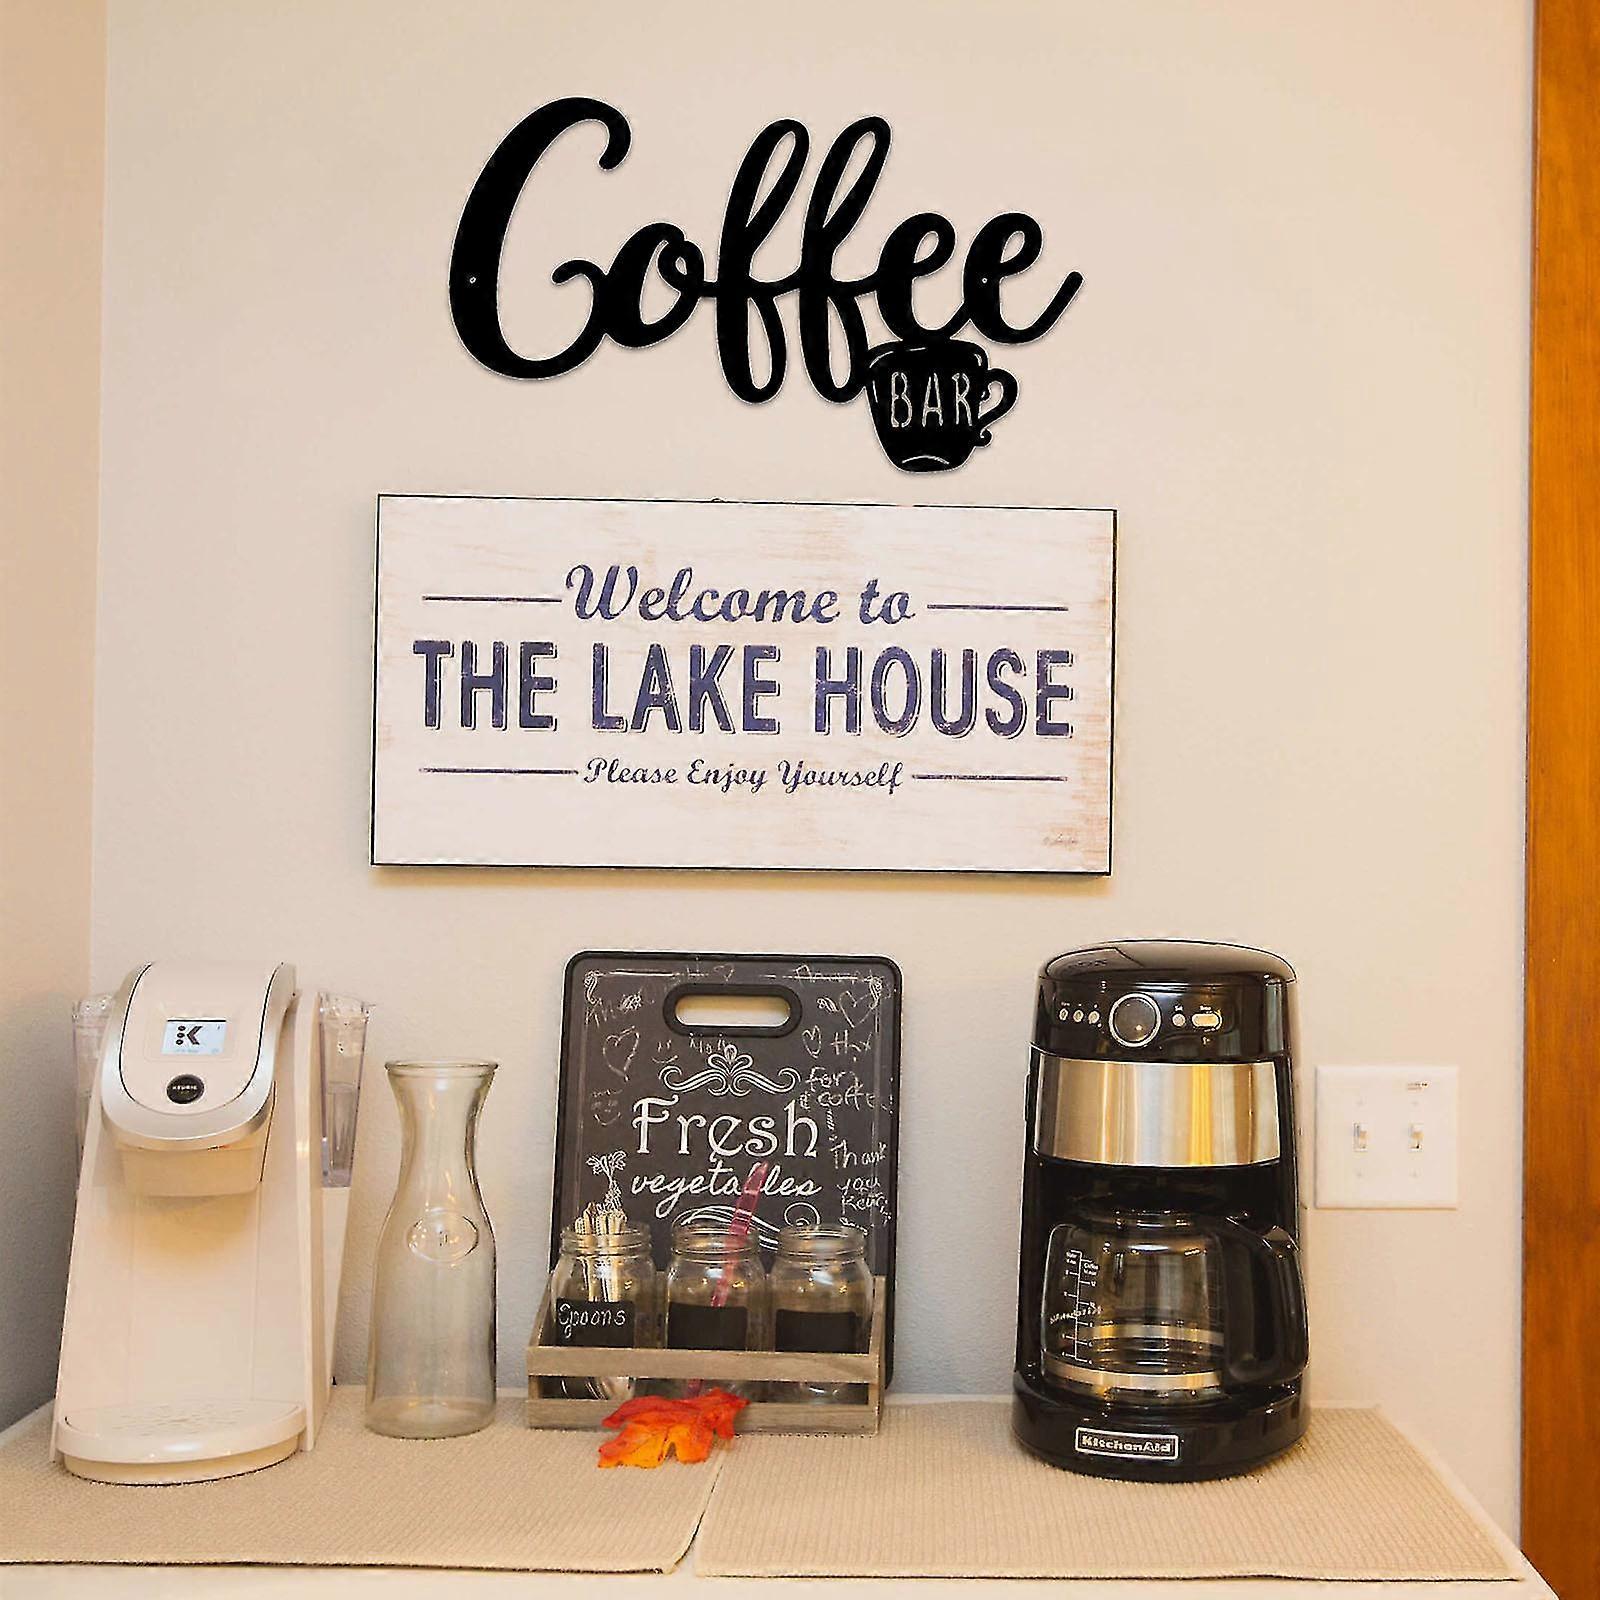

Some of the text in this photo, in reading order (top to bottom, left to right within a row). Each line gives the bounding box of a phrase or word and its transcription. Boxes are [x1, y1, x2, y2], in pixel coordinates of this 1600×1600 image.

[450, 97, 1084, 404] Coffee
[890, 371, 973, 428] BAR
[565, 564, 916, 625] Welcome to
[413, 639, 1075, 739] THE LAKE HOUSE
[583, 757, 904, 795] Please Enjoy Yourself
[632, 1094, 819, 1164] Fresh
[559, 1302, 627, 1339] Spoons
[1081, 1434, 1172, 1453] KitchenAid
